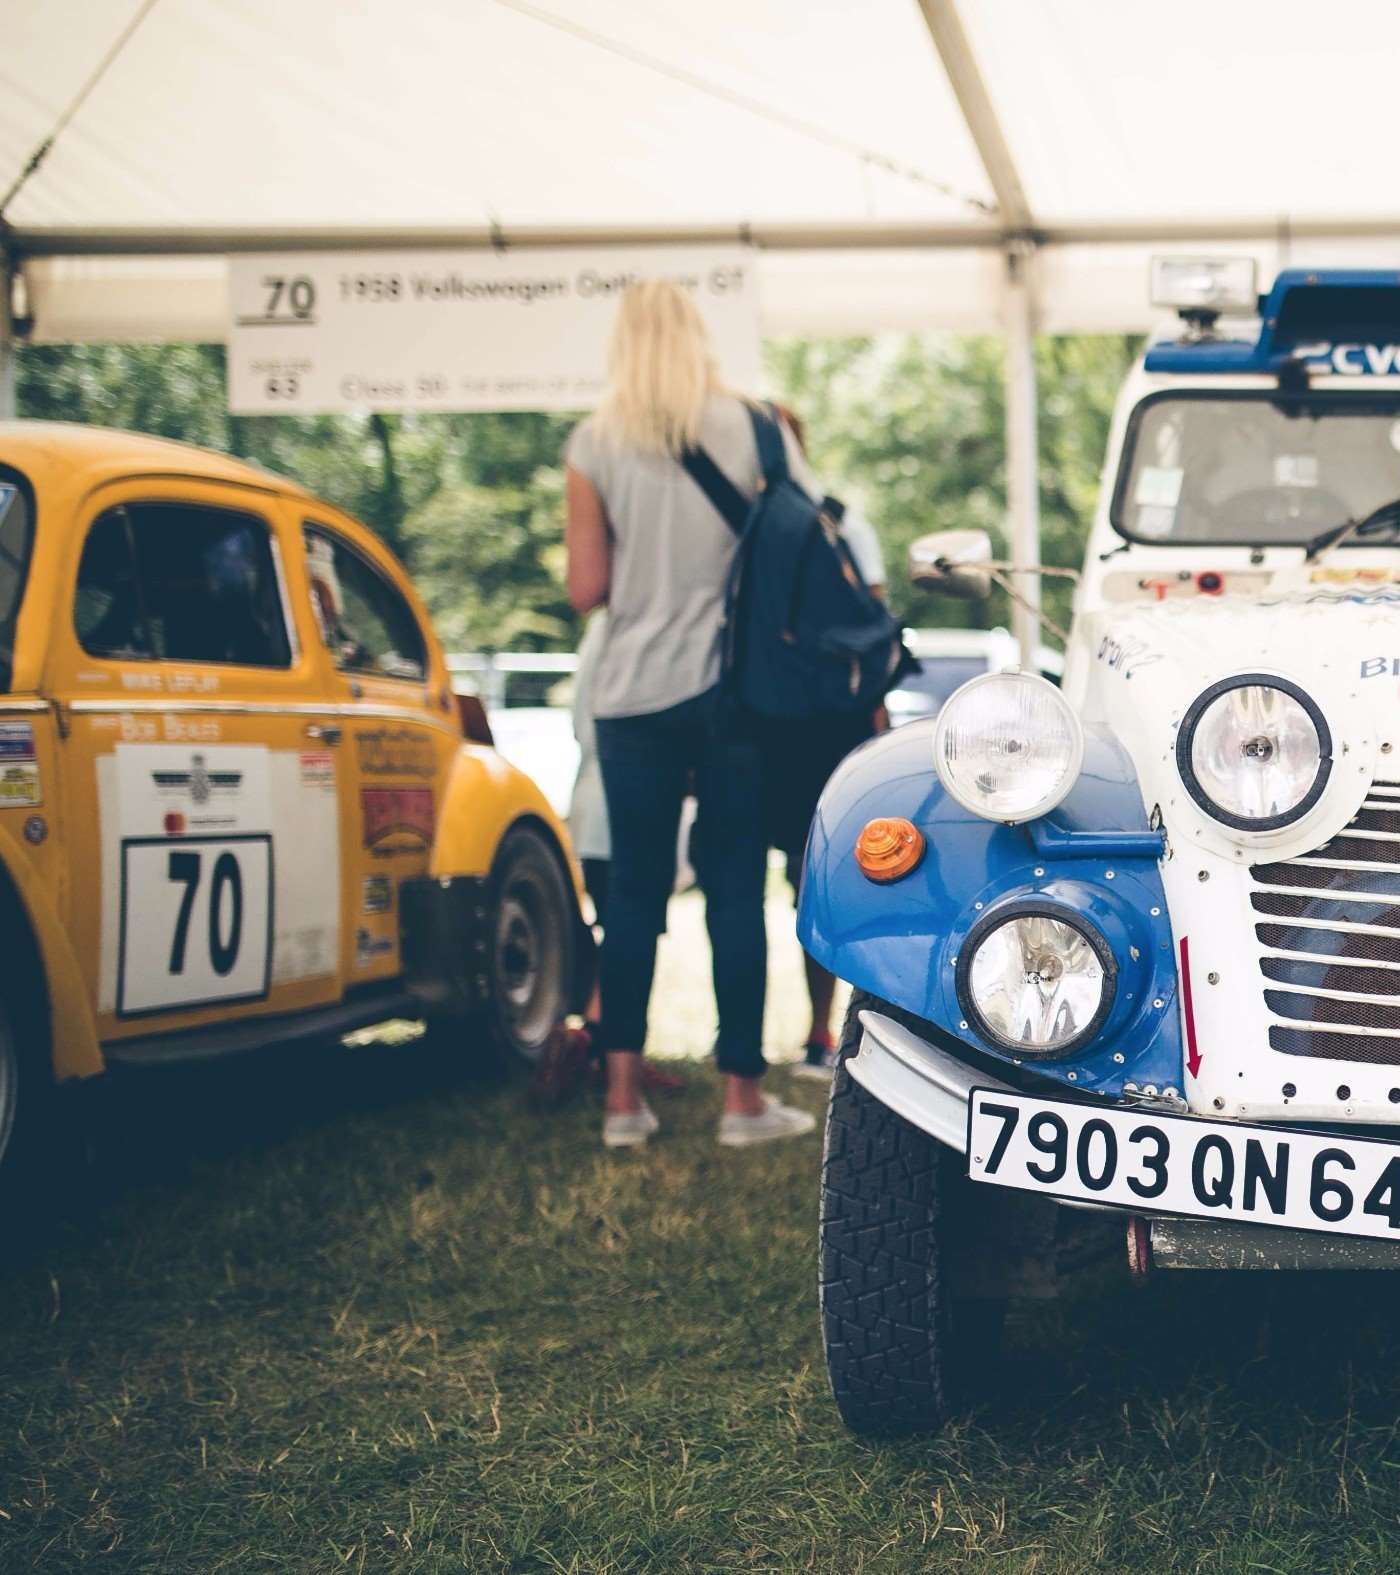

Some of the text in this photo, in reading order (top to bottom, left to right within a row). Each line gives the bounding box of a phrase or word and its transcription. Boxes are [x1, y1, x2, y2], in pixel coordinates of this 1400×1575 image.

[261, 275, 316, 320] 70
[408, 268, 567, 305] Volkswagen
[168, 851, 244, 977] 70
[978, 1101, 1171, 1199] 7903
[1191, 1133, 1290, 1215] QN
